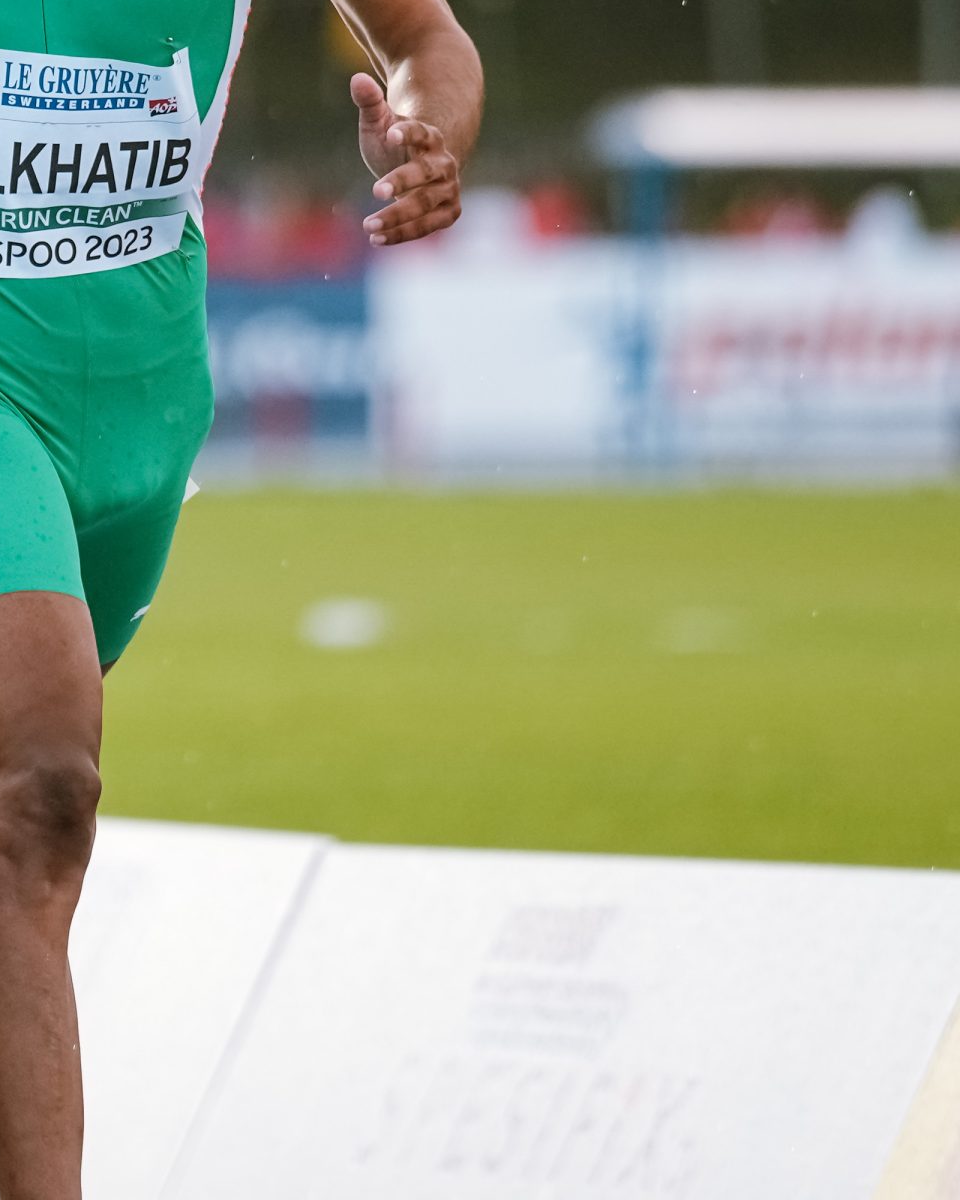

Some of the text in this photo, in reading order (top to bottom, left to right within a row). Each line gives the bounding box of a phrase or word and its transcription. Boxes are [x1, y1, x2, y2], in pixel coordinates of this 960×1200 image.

[3, 61, 32, 91] LE
[7, 95, 139, 110] SWITZERLAND
[0, 208, 51, 230] RUN
[85, 225, 153, 262] 2023
